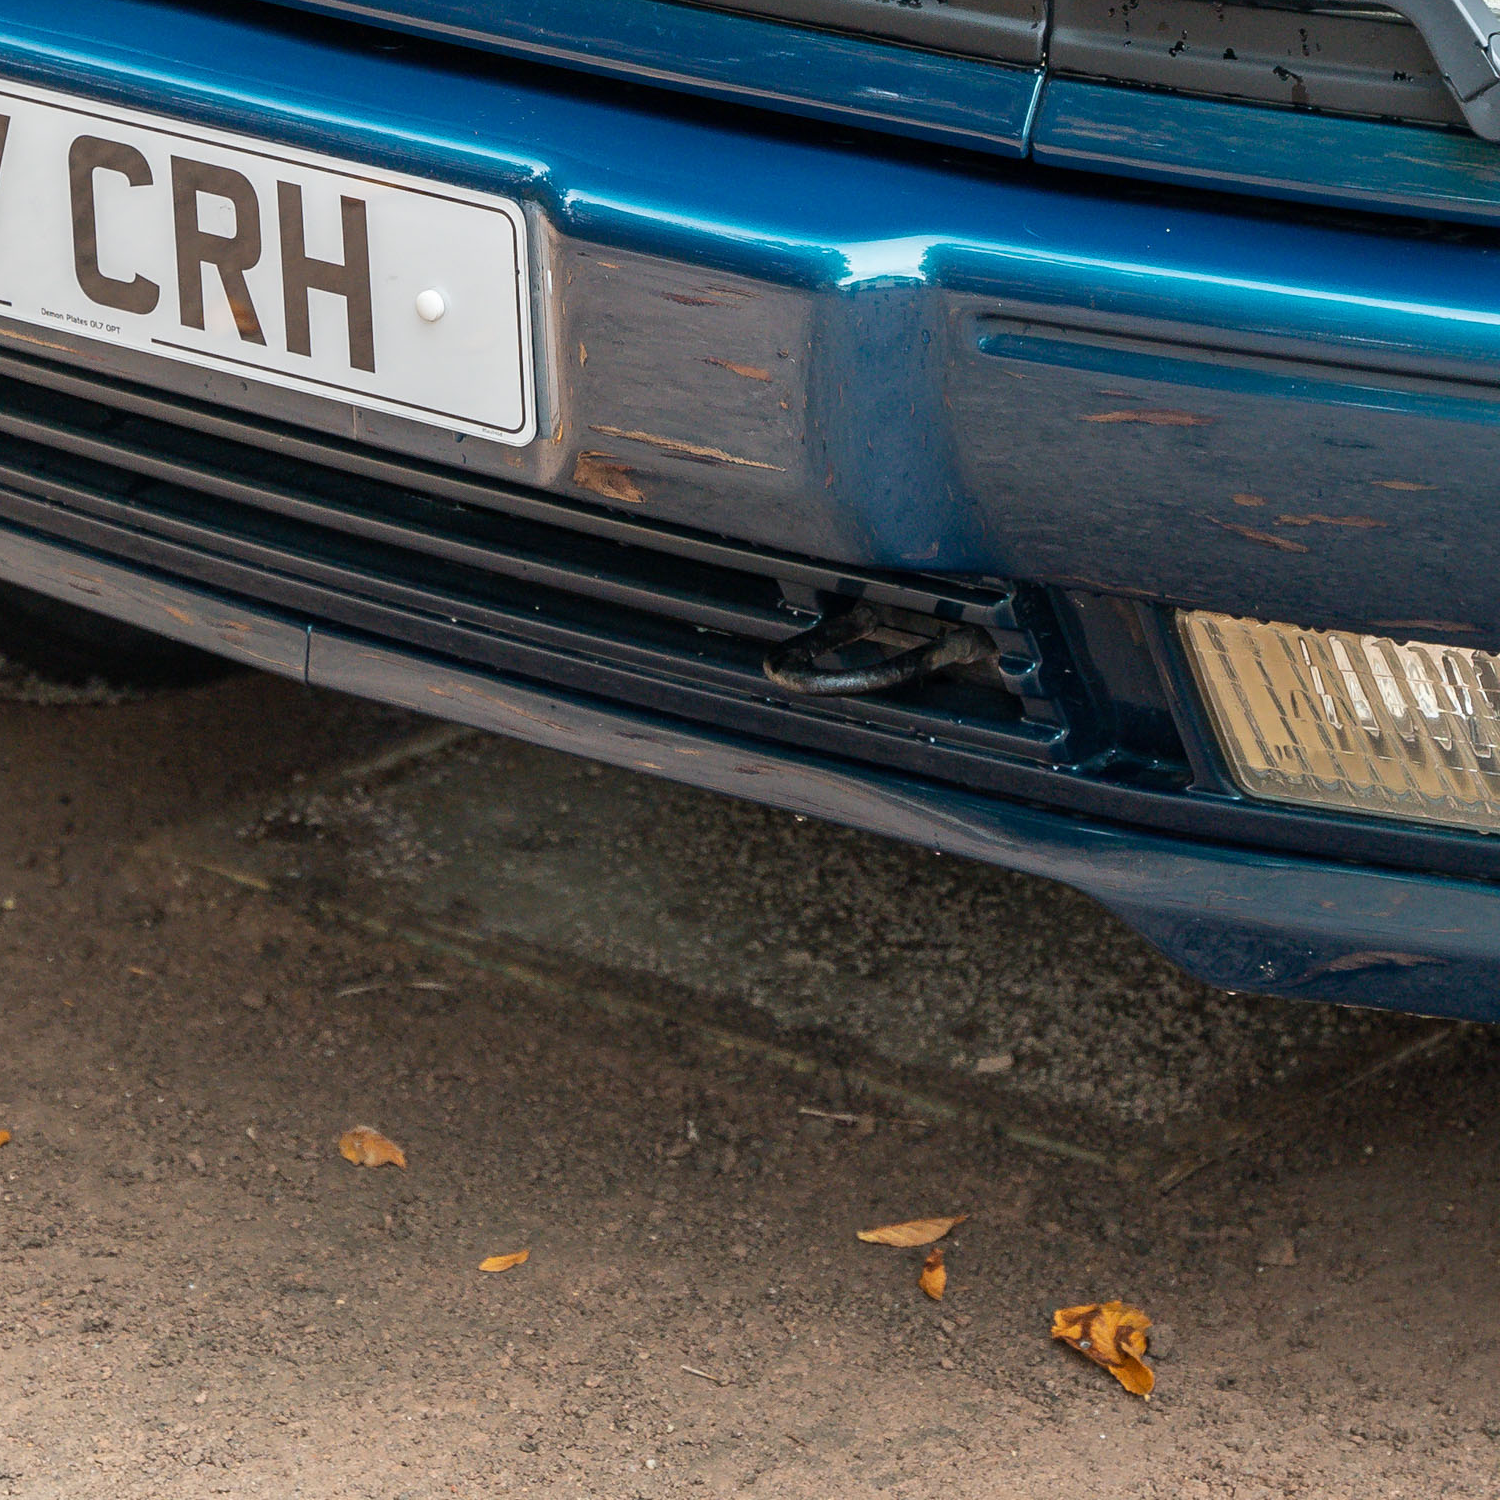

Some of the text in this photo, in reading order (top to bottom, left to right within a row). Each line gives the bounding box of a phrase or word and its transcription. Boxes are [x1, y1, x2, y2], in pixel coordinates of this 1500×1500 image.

[41, 307, 64, 320] Demon
[66, 313, 88, 326] Plates
[67, 133, 376, 375] CRH
